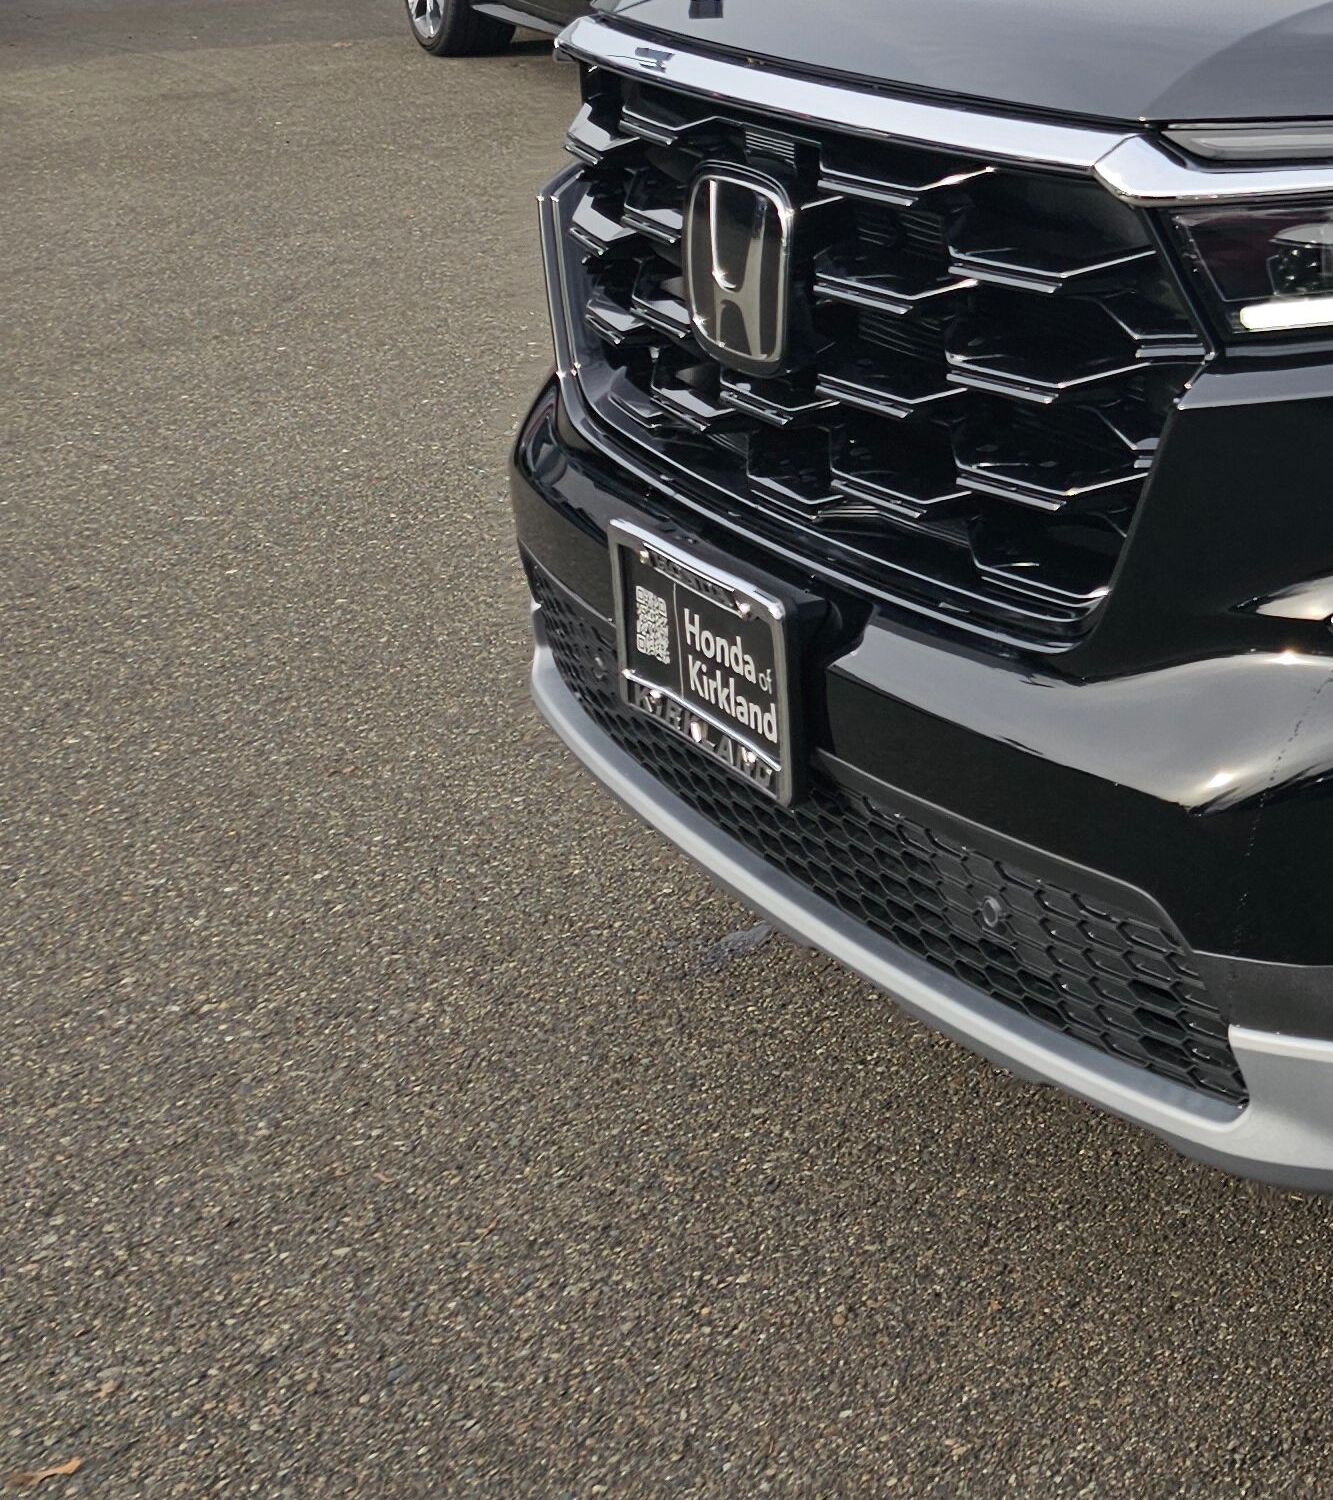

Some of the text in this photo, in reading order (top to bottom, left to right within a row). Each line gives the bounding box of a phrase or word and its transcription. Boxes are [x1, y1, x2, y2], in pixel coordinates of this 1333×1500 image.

[684, 607, 774, 695] Honda of
[688, 655, 778, 744] Kirkland
